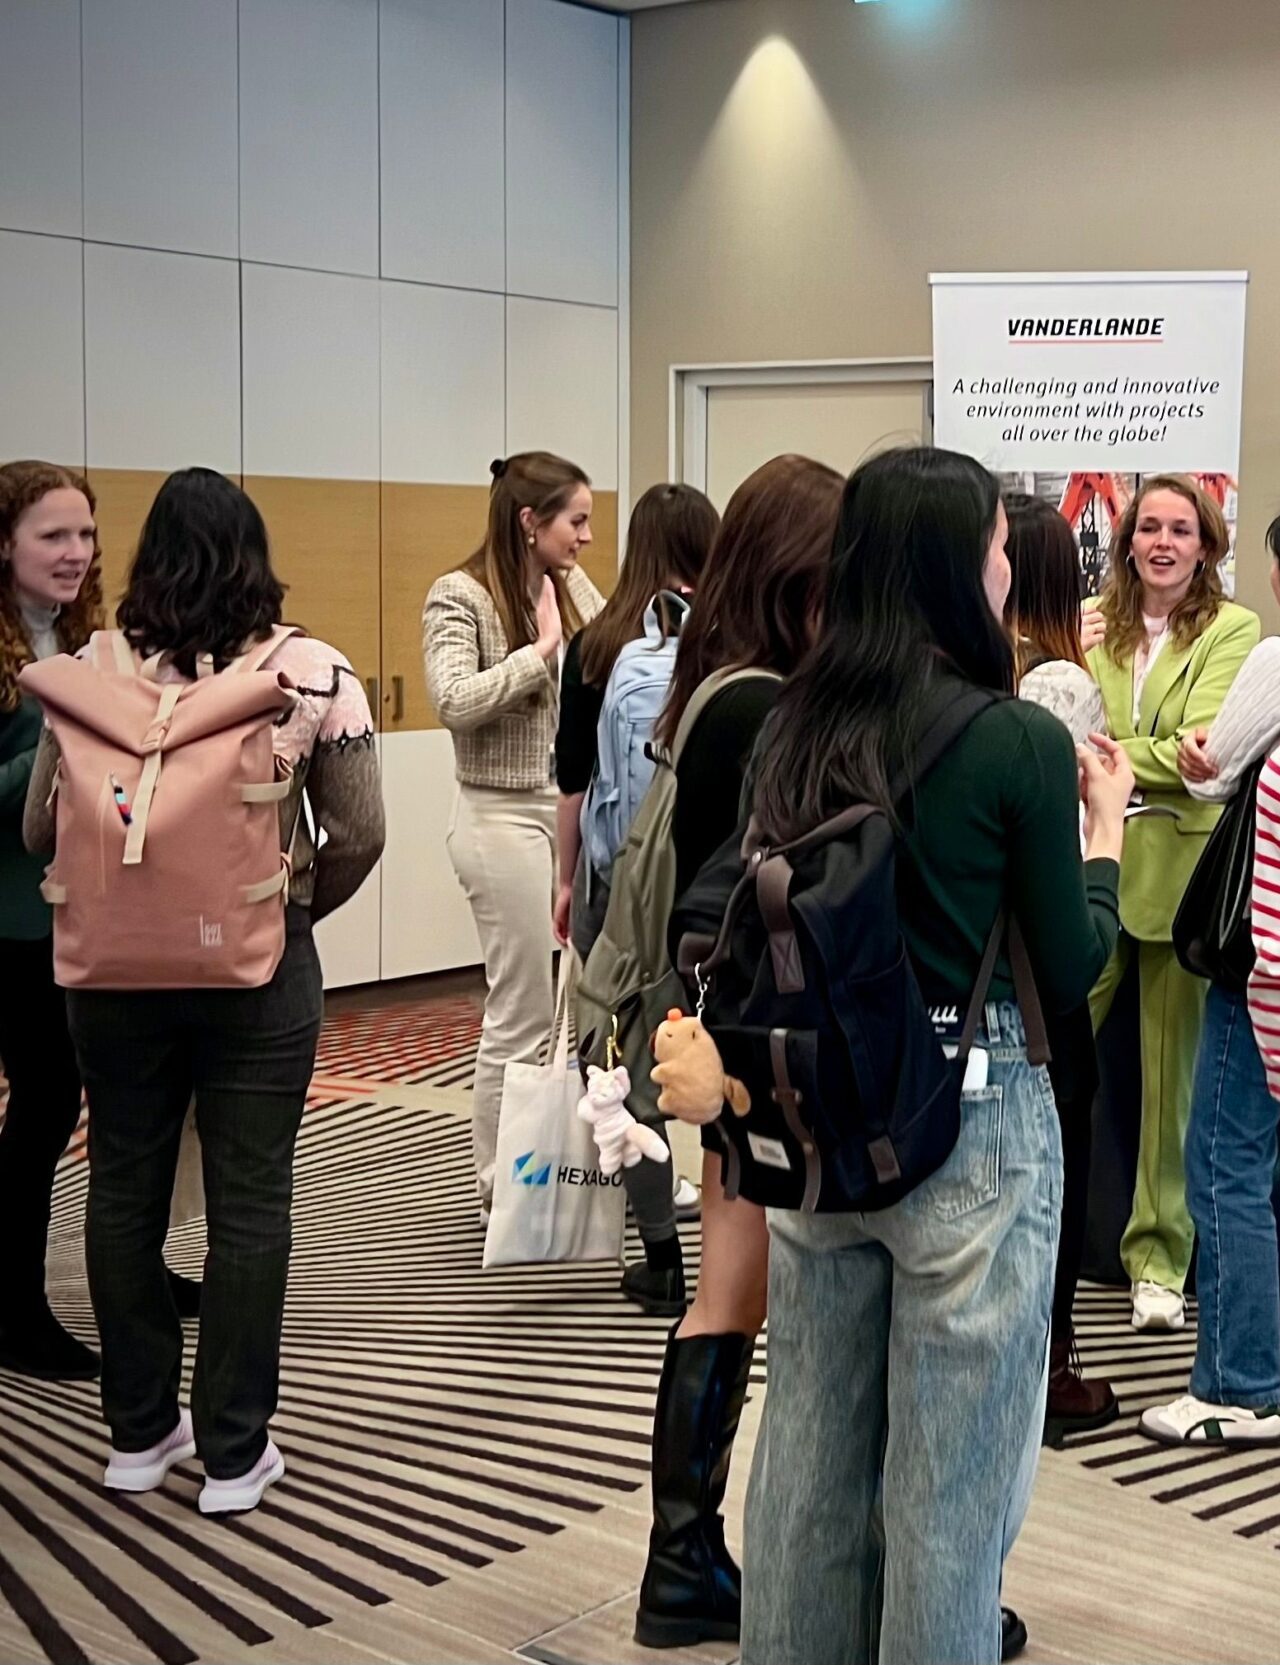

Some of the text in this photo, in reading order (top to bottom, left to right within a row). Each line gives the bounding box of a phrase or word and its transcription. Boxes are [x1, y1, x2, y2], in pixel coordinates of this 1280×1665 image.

[1008, 317, 1165, 337] VANDERLANDE
[952, 376, 1220, 398] A challenging and innovative
[966, 401, 1205, 422] environment with projects
[1001, 424, 1168, 446] all over the globe!
